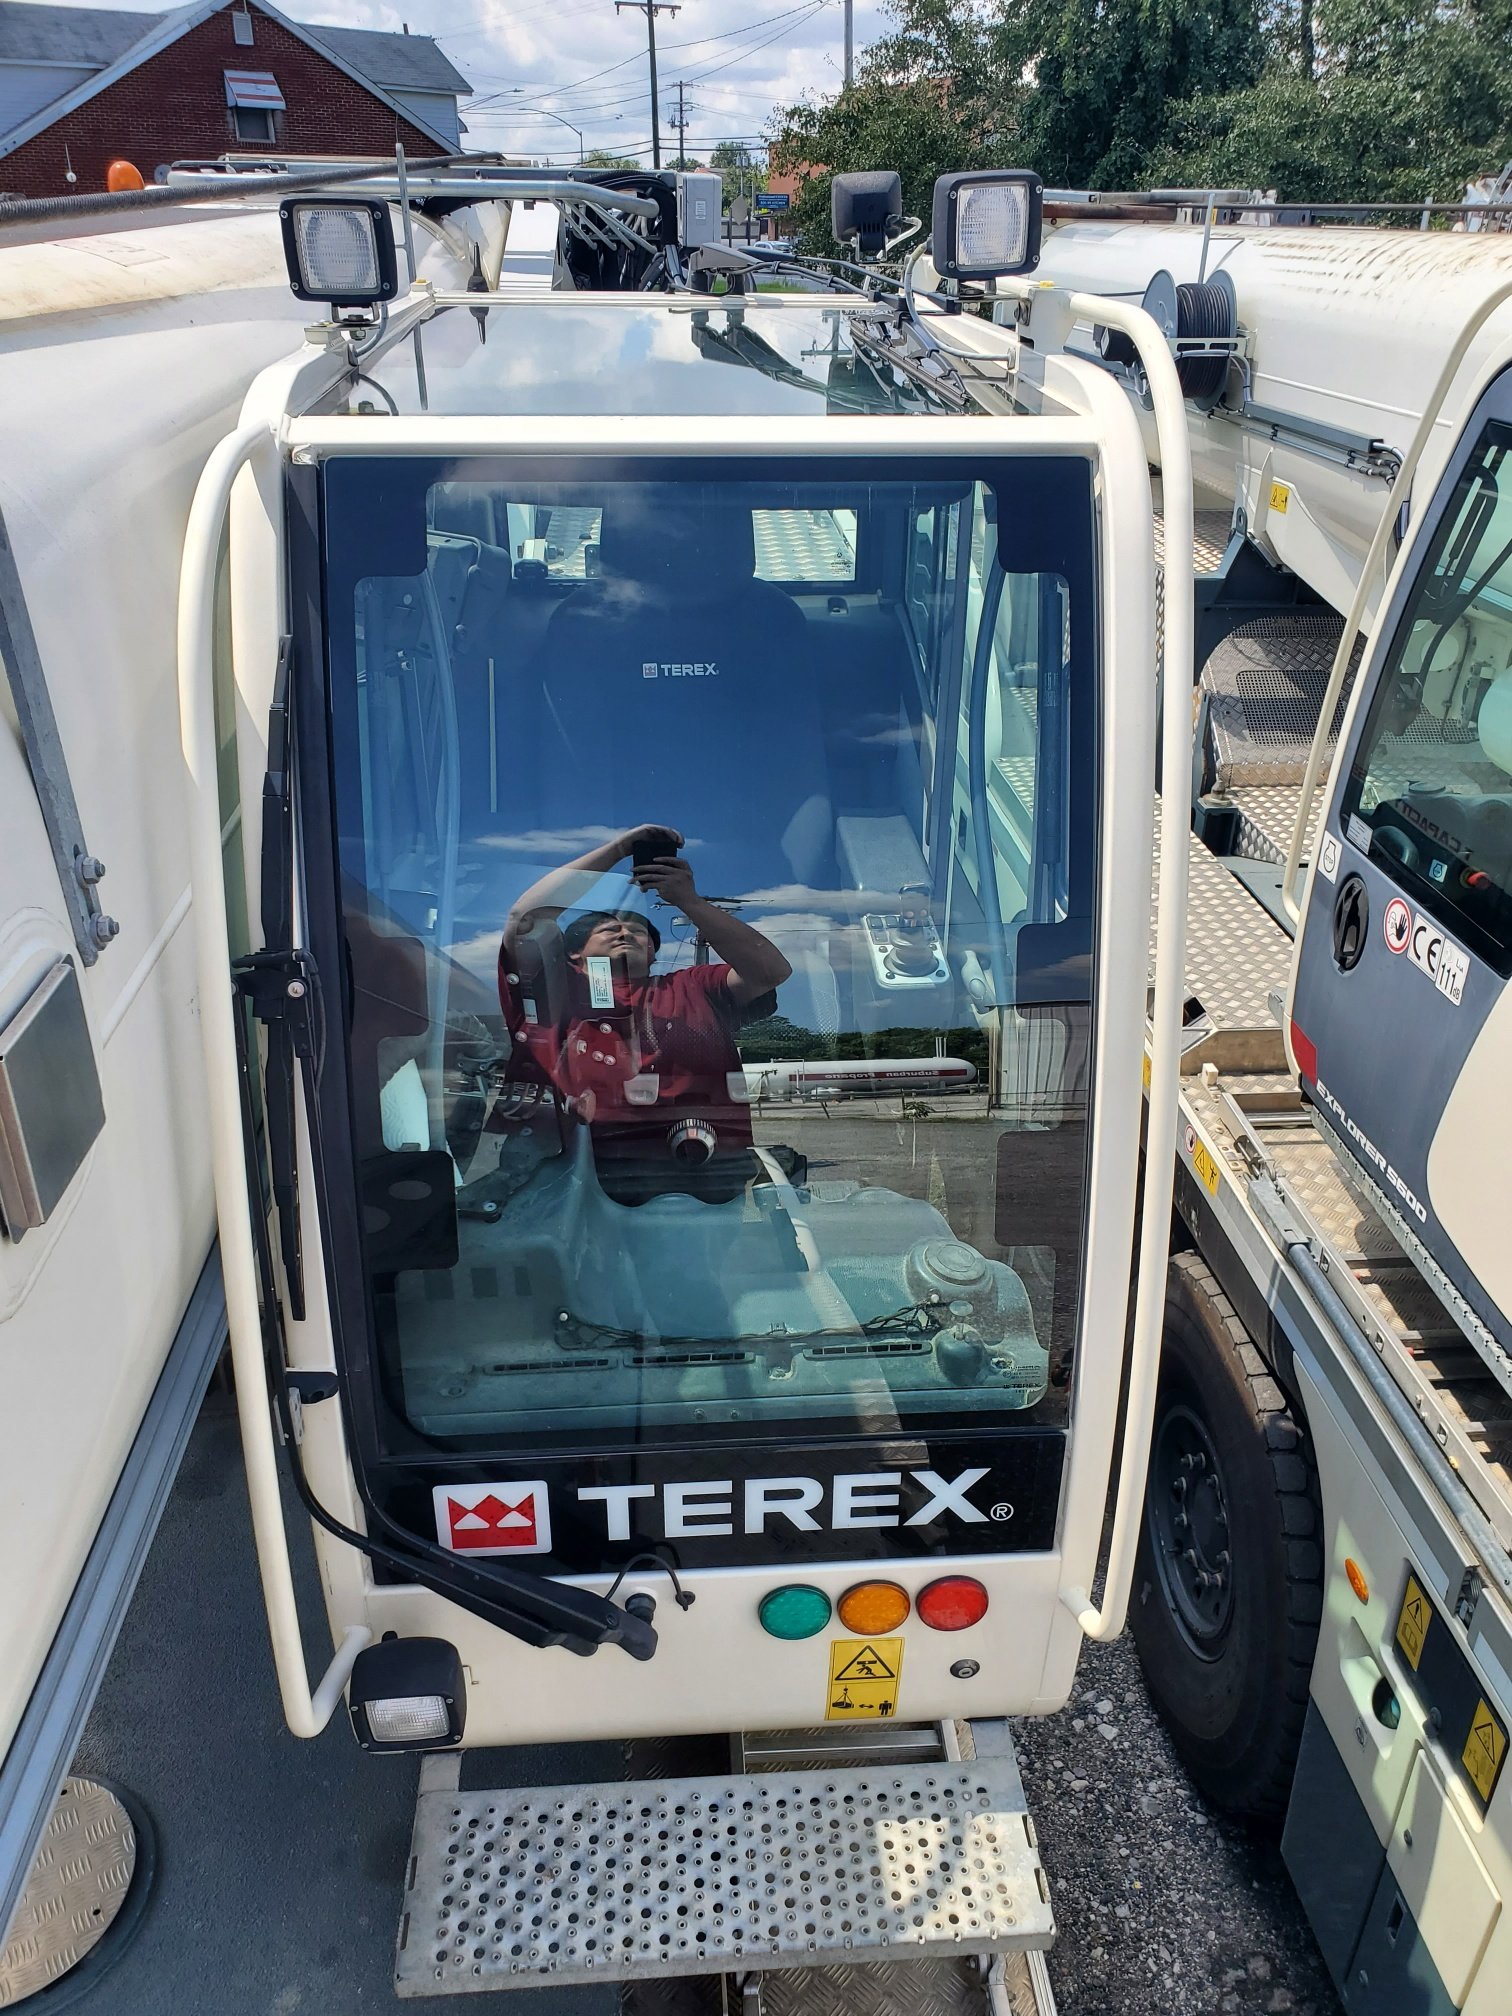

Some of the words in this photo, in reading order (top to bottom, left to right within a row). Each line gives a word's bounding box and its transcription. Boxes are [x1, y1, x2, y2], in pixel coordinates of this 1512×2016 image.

[660, 663, 718, 676] TEREX
[1413, 925, 1441, 974] CE
[1439, 963, 1457, 995] 111
[1316, 1079, 1387, 1173] EXPLORER
[1386, 1165, 1428, 1224] 5600
